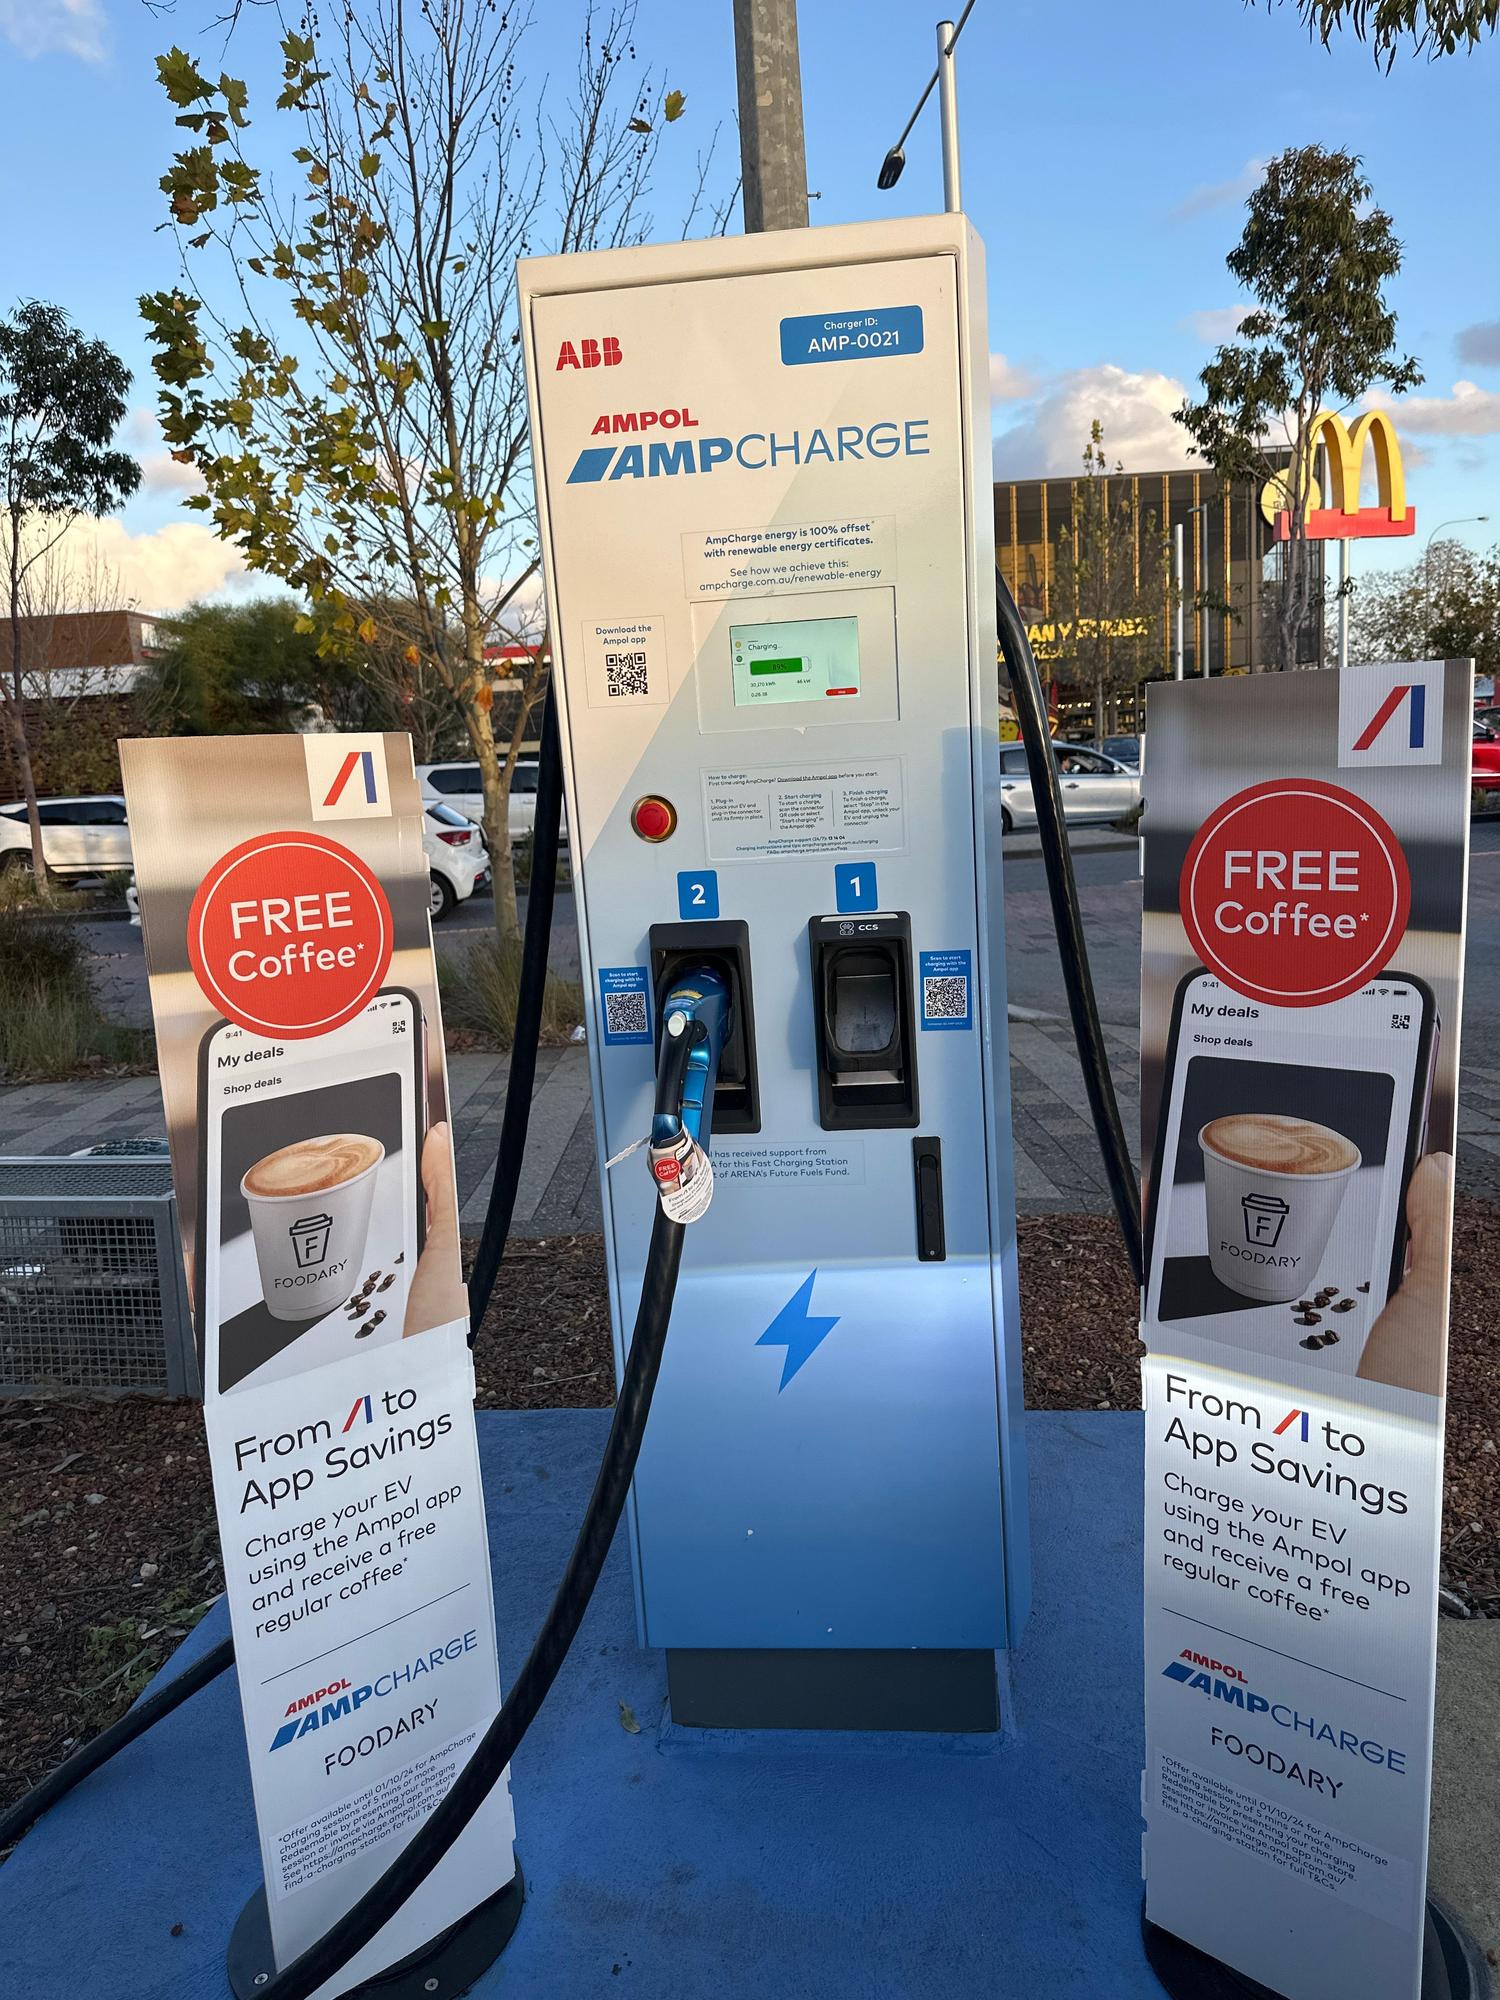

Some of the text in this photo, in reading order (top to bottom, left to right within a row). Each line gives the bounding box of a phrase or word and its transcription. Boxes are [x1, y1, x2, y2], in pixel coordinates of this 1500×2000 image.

[824, 317, 878, 331] Charger ID:
[555, 337, 623, 371] ABB
[808, 330, 900, 354] AMP-0021
[591, 408, 699, 436] AMPOL
[608, 420, 930, 481] AMPCHARGE
[704, 537, 873, 558] with renewable energy certificates.
[706, 534, 762, 546] AmpCharge
[764, 530, 798, 540] energy
[800, 528, 807, 536] is
[810, 526, 838, 536] 100%
[700, 569, 882, 591] ampcharge.com.au/renewable-energy
[730, 568, 748, 577] See
[750, 566, 770, 575] how
[790, 562, 825, 571] achieve
[828, 560, 848, 568] this:
[596, 626, 636, 634] Download
[603, 636, 628, 645] Ampol
[850, 876, 860, 896] 1
[1224, 850, 1360, 892] FREE
[690, 884, 706, 905] 2
[230, 891, 353, 940] FREE
[1202, 981, 1219, 989] 9:41
[1191, 1003, 1260, 1019] My deals
[225, 1030, 243, 1039] 9:41
[1193, 1034, 1253, 1047] Shop deals
[218, 1046, 284, 1068] My deals
[224, 1076, 282, 1095] Shop deals
[659, 1162, 676, 1171] FREE
[774, 1159, 813, 1168] Charging
[1256, 1216, 1271, 1237] F
[306, 1236, 318, 1259] F
[1221, 1241, 1301, 1267] FOODARY
[275, 1259, 347, 1288] FOODARY
[235, 1420, 331, 1471] From
[382, 1388, 417, 1416] to
[1166, 1373, 1261, 1430] From
[1322, 1421, 1365, 1456] to
[240, 1413, 452, 1514] App Savings
[1164, 1417, 1408, 1515] App Savings
[245, 1475, 412, 1558] Charge your EV
[1164, 1472, 1347, 1544] Charge your EV
[249, 1485, 462, 1585] using the Ampol app
[1164, 1502, 1410, 1597] using the Ampol app
[252, 1522, 436, 1611] and receive a free
[1164, 1528, 1370, 1610] and receive a free
[1164, 1553, 1240, 1590] regular
[255, 1593, 332, 1638] regular
[1179, 1648, 1248, 1684] AMPOL
[284, 1678, 352, 1717] AMPOL
[296, 1629, 478, 1739] AMPCHARGE
[324, 1698, 438, 1775] FOODARY
[1189, 1672, 1406, 1775] AMPCHARGE
[310, 1802, 351, 1828] available
[354, 1789, 373, 1806] until
[375, 1769, 414, 1793] 01/10/24
[415, 1759, 428, 1770] for
[429, 1732, 476, 1764] AmpCharge
[1211, 1726, 1343, 1799] FOODARY
[279, 1830, 320, 1855] charging
[323, 1811, 360, 1831] sessions
[362, 1804, 372, 1813] of
[381, 1785, 401, 1799] mins
[404, 1779, 413, 1788] or
[414, 1766, 437, 1782] more.
[1192, 1771, 1233, 1796] available
[1236, 1790, 1257, 1806] until
[1259, 1801, 1304, 1828] 01/10/24
[1307, 1823, 1322, 1836] for
[1324, 1832, 1388, 1866] AmpCharge
